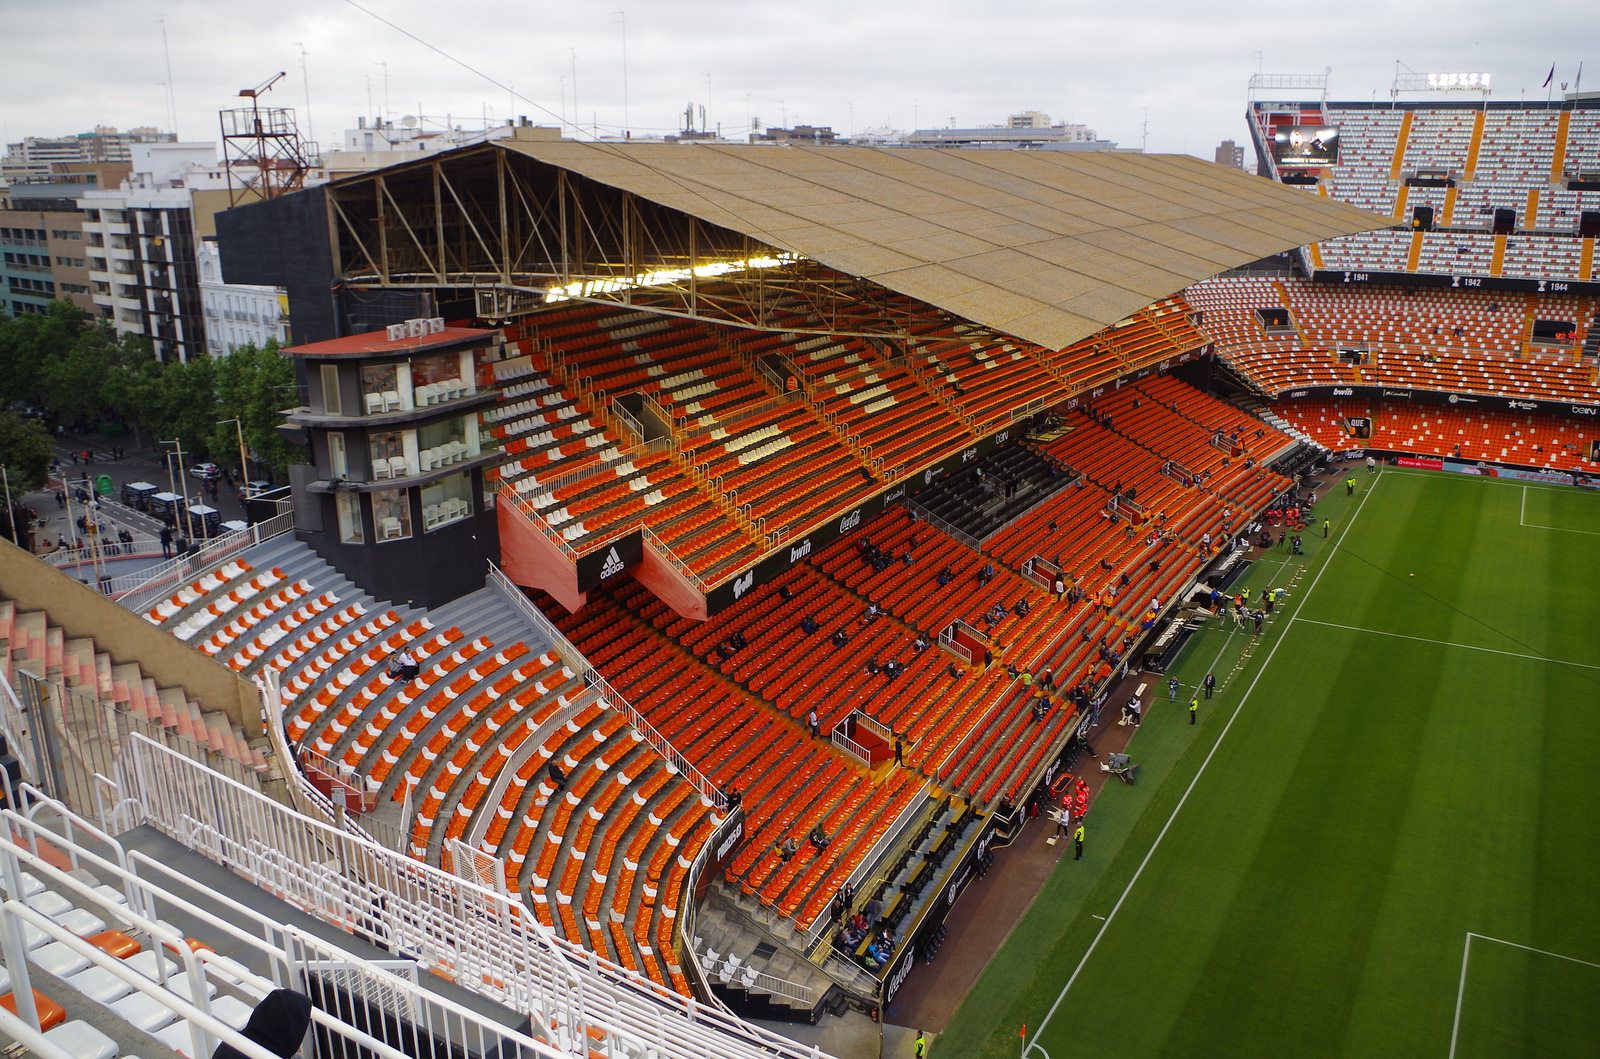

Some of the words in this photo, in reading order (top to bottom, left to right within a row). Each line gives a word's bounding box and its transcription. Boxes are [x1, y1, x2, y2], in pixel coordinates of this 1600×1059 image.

[1353, 273, 1368, 281] 1941
[1464, 278, 1481, 286] 1942
[1551, 283, 1568, 291] 1944
[1333, 388, 1353, 396] bwin
[1350, 419, 1364, 427] QUE
[790, 541, 812, 563] bwin
[600, 560, 624, 580] adidas
